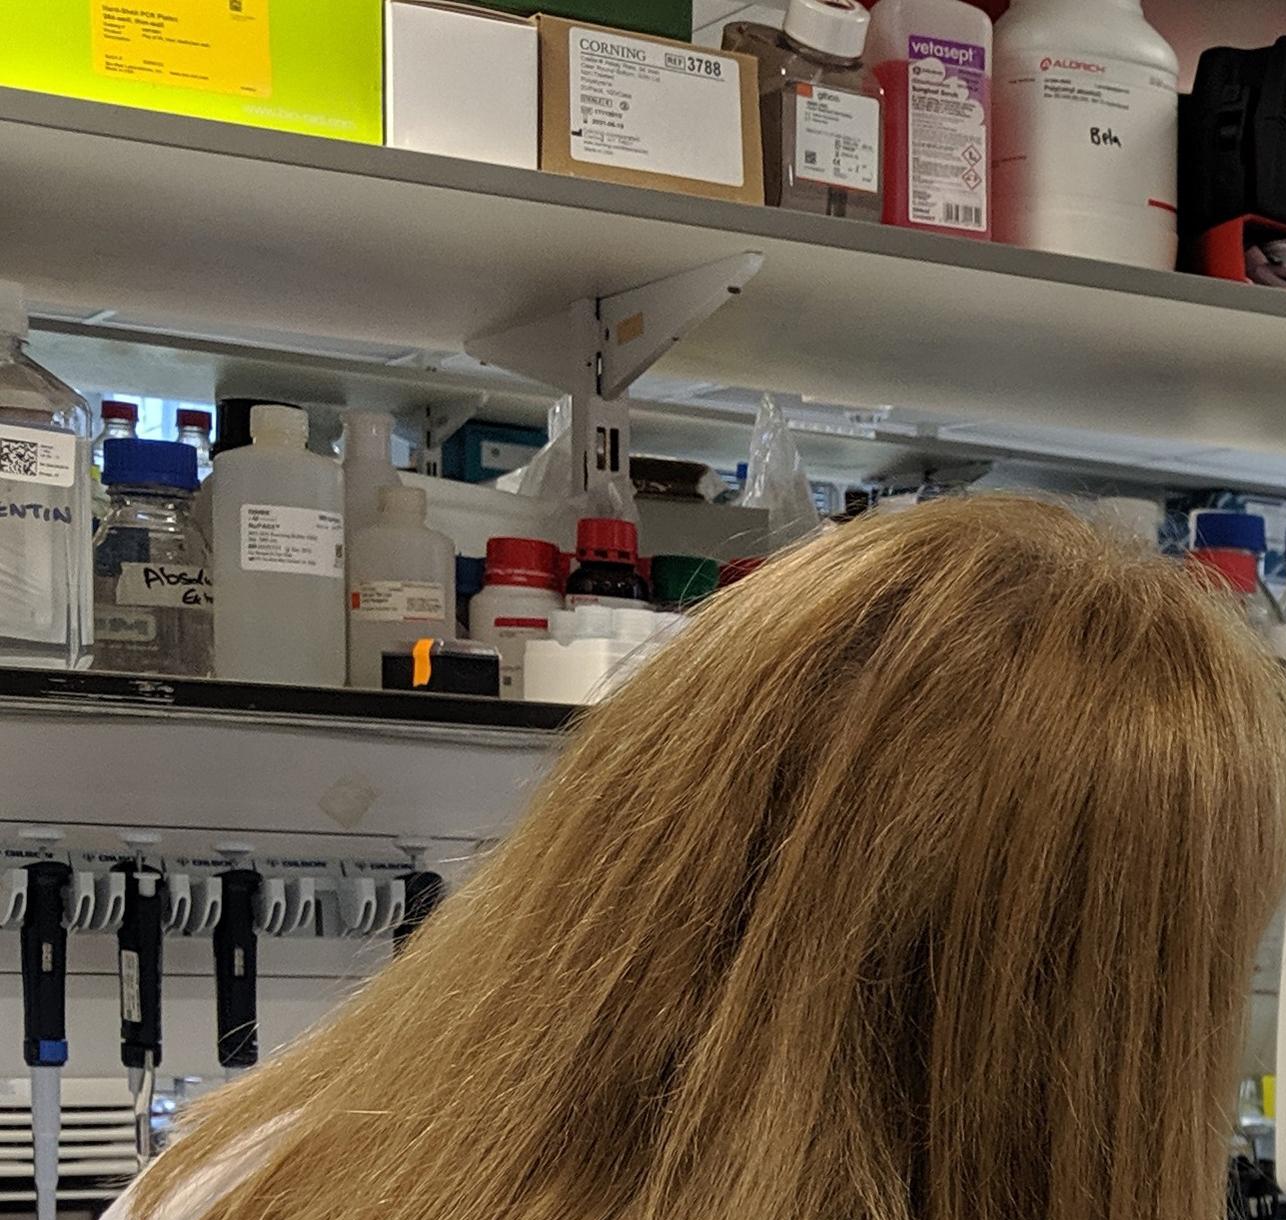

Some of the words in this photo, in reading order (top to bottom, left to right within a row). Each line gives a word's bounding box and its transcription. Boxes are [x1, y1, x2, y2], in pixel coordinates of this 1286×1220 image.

[579, 38, 647, 62] CORNING
[687, 56, 722, 77] 3788
[1053, 59, 1106, 73] ALDRICH
[282, 859, 326, 868] GILSON
